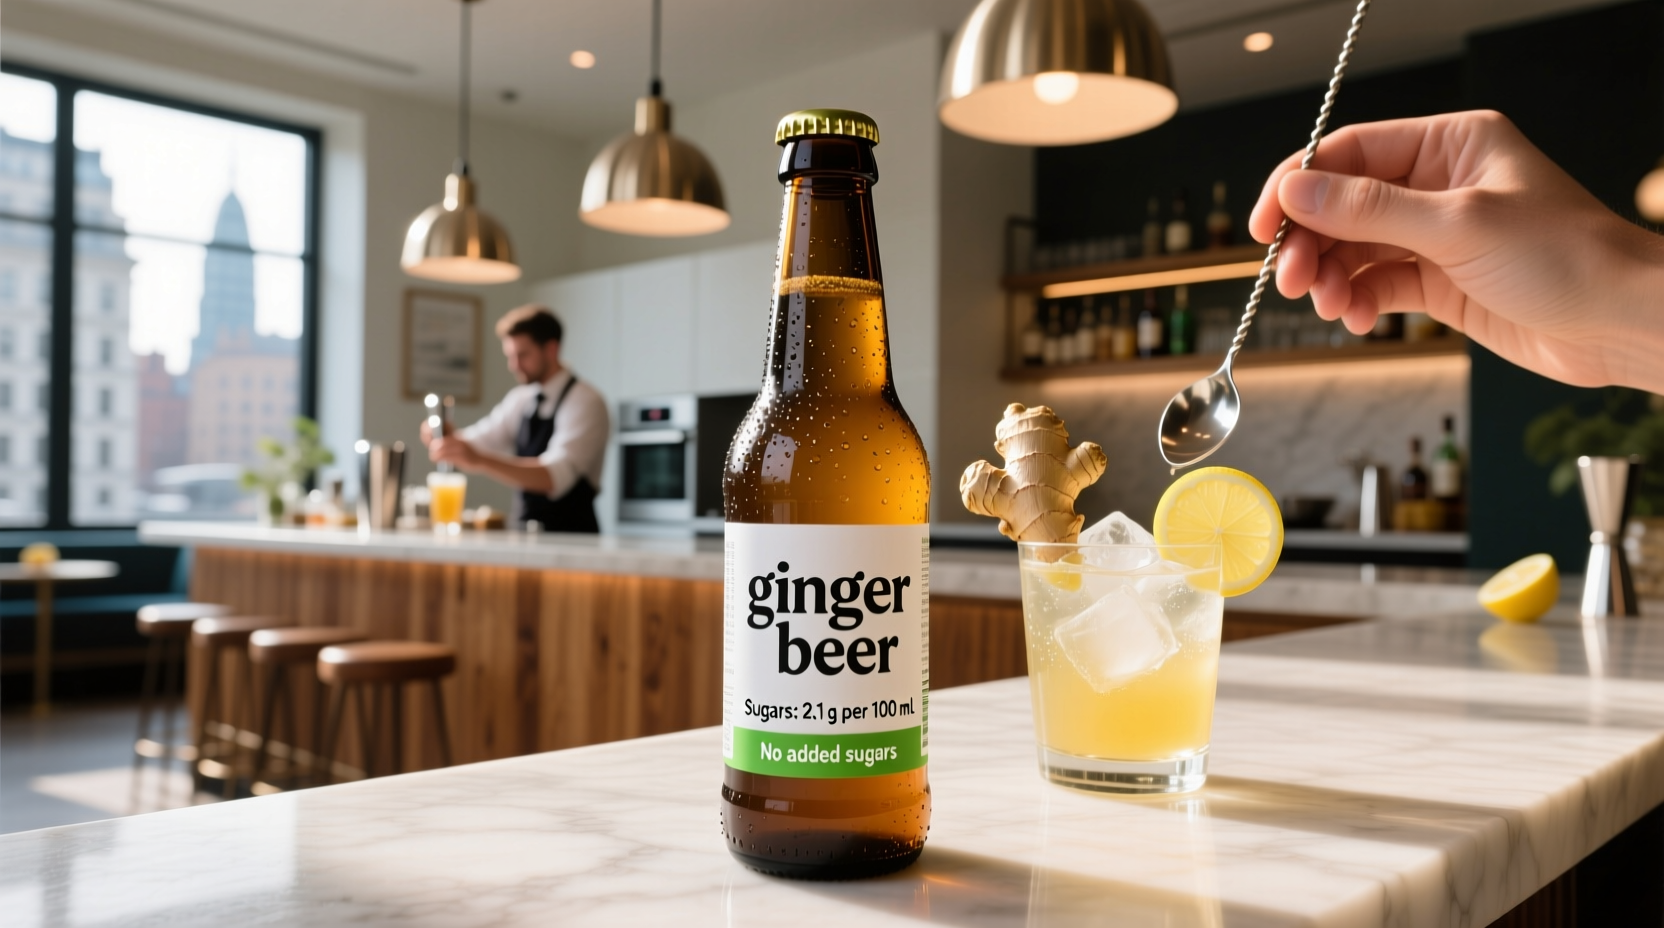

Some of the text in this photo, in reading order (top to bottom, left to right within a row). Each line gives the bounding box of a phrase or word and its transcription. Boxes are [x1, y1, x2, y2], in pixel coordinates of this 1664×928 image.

[746, 561, 911, 631] ginger
[775, 621, 899, 676] beer
[744, 697, 915, 725] Sugars: 2.1 g per 100 ml
[760, 741, 897, 767] No added sugars
